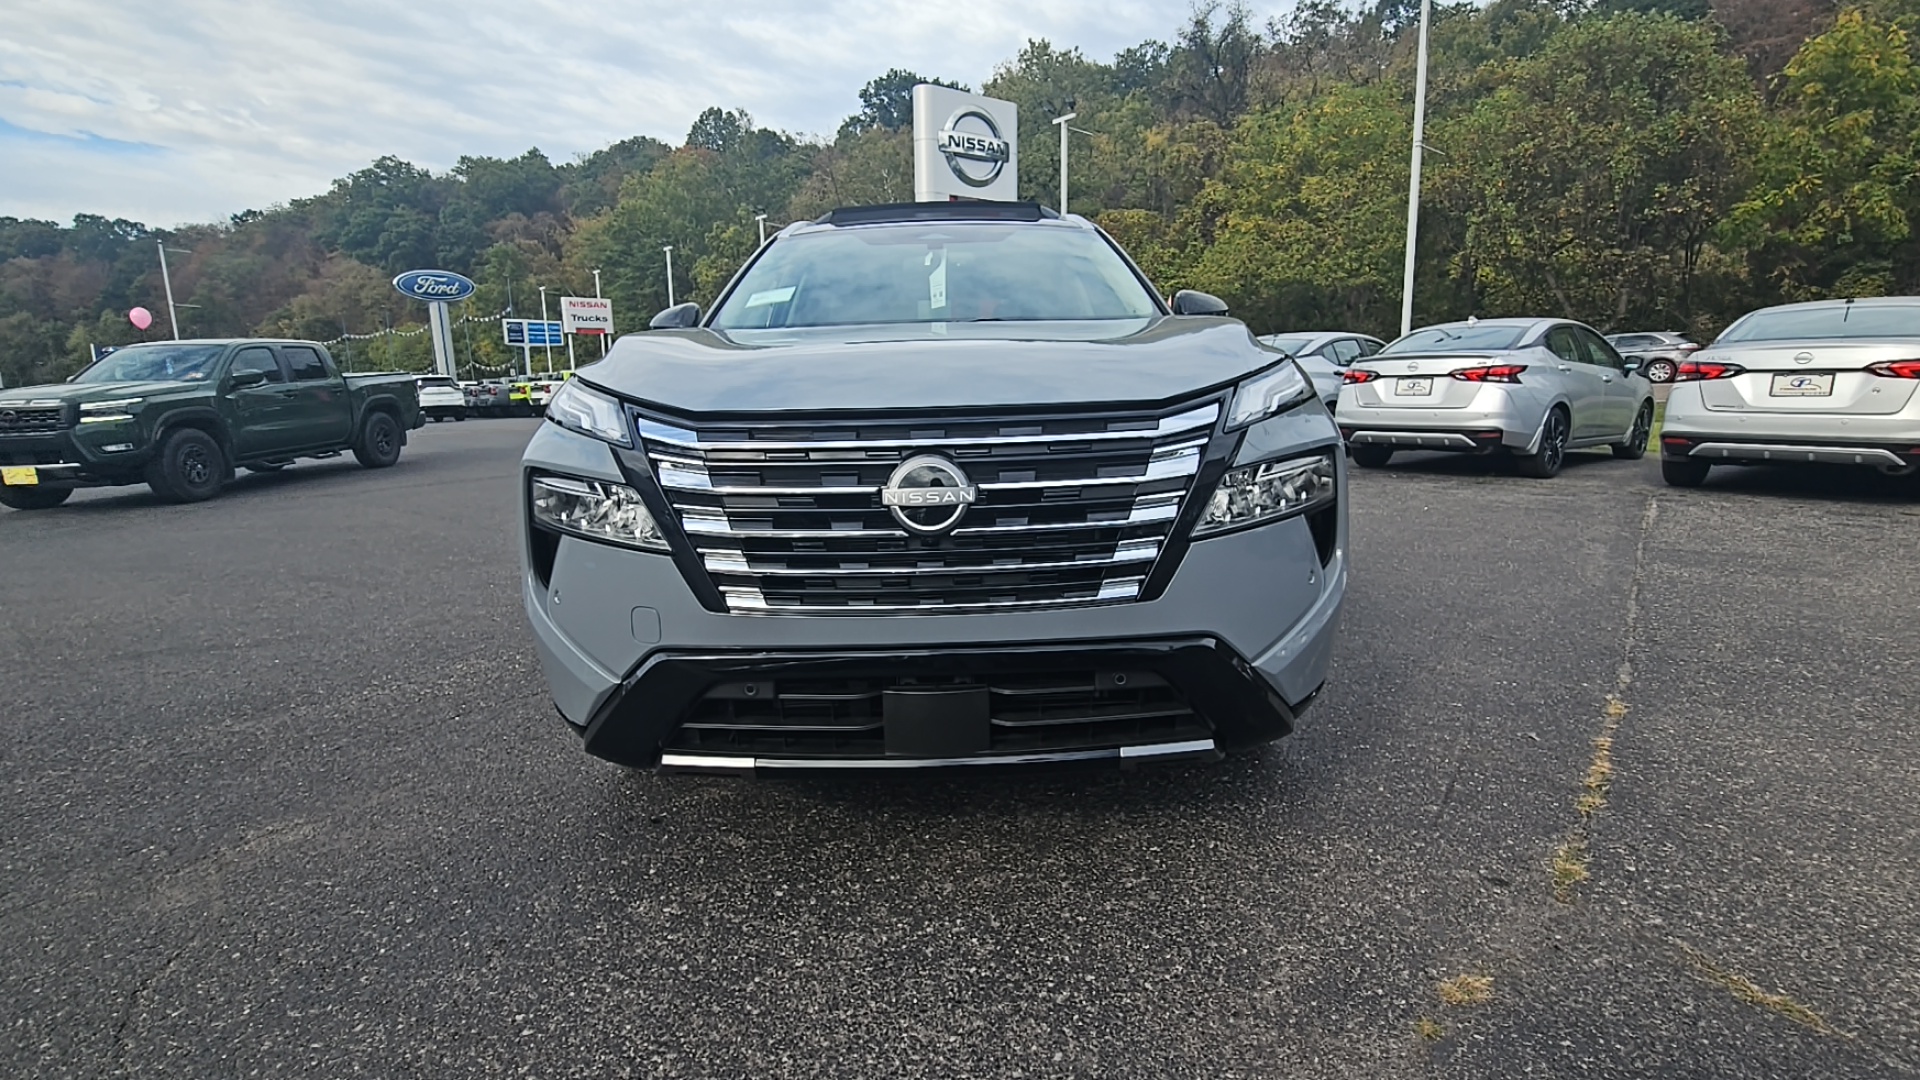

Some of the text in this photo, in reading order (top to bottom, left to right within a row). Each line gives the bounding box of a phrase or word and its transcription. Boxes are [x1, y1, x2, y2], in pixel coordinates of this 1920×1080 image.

[948, 135, 1005, 155] NISSAN
[413, 275, 459, 294] Ford
[569, 300, 608, 309] NISSAN
[571, 314, 608, 322] Trucks
[885, 489, 973, 504] NISSAN
